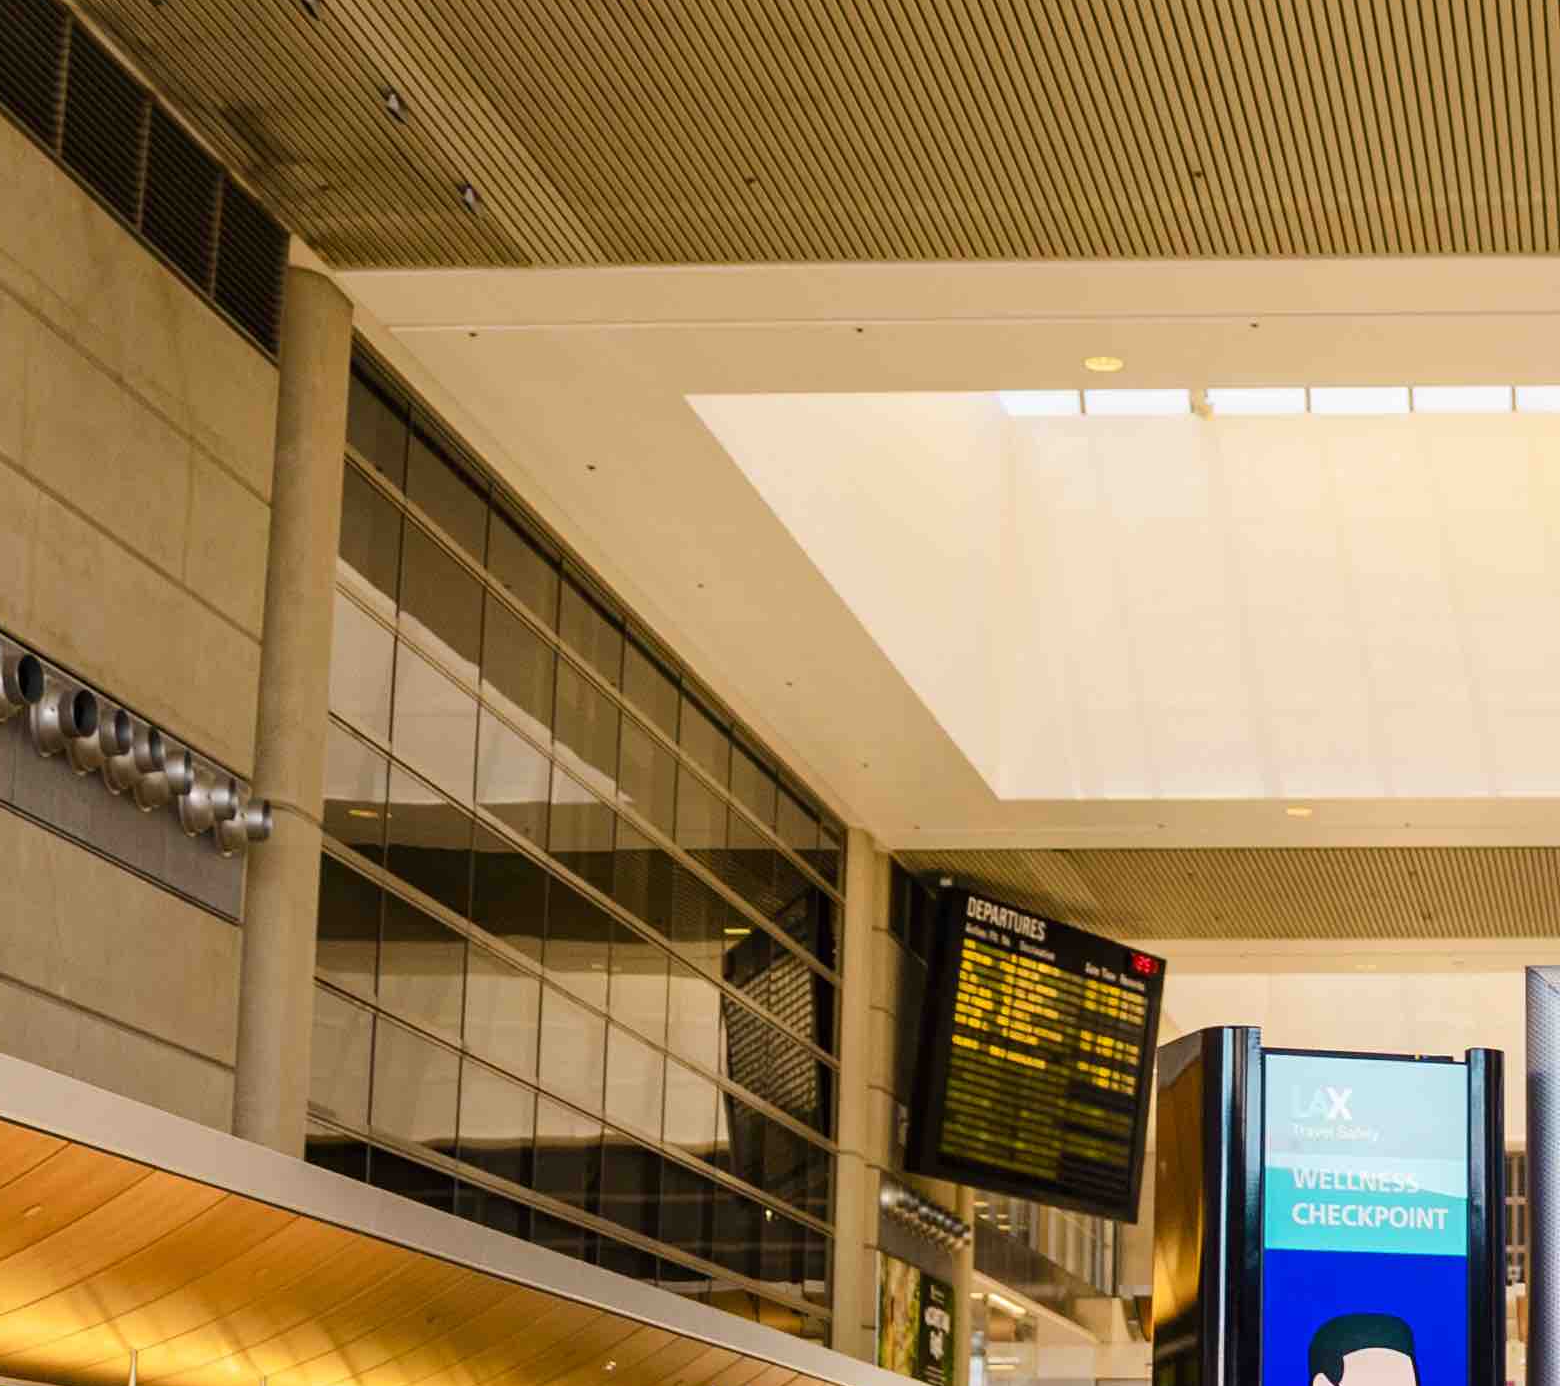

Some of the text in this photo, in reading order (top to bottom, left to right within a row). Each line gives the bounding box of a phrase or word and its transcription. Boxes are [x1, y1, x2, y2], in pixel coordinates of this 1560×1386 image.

[967, 897, 1045, 941] DEPARTURES
[1292, 1085, 1351, 1121] LAX
[1292, 1167, 1420, 1195] WELLNESS
[1292, 1202, 1448, 1231] CHECKPOINT
